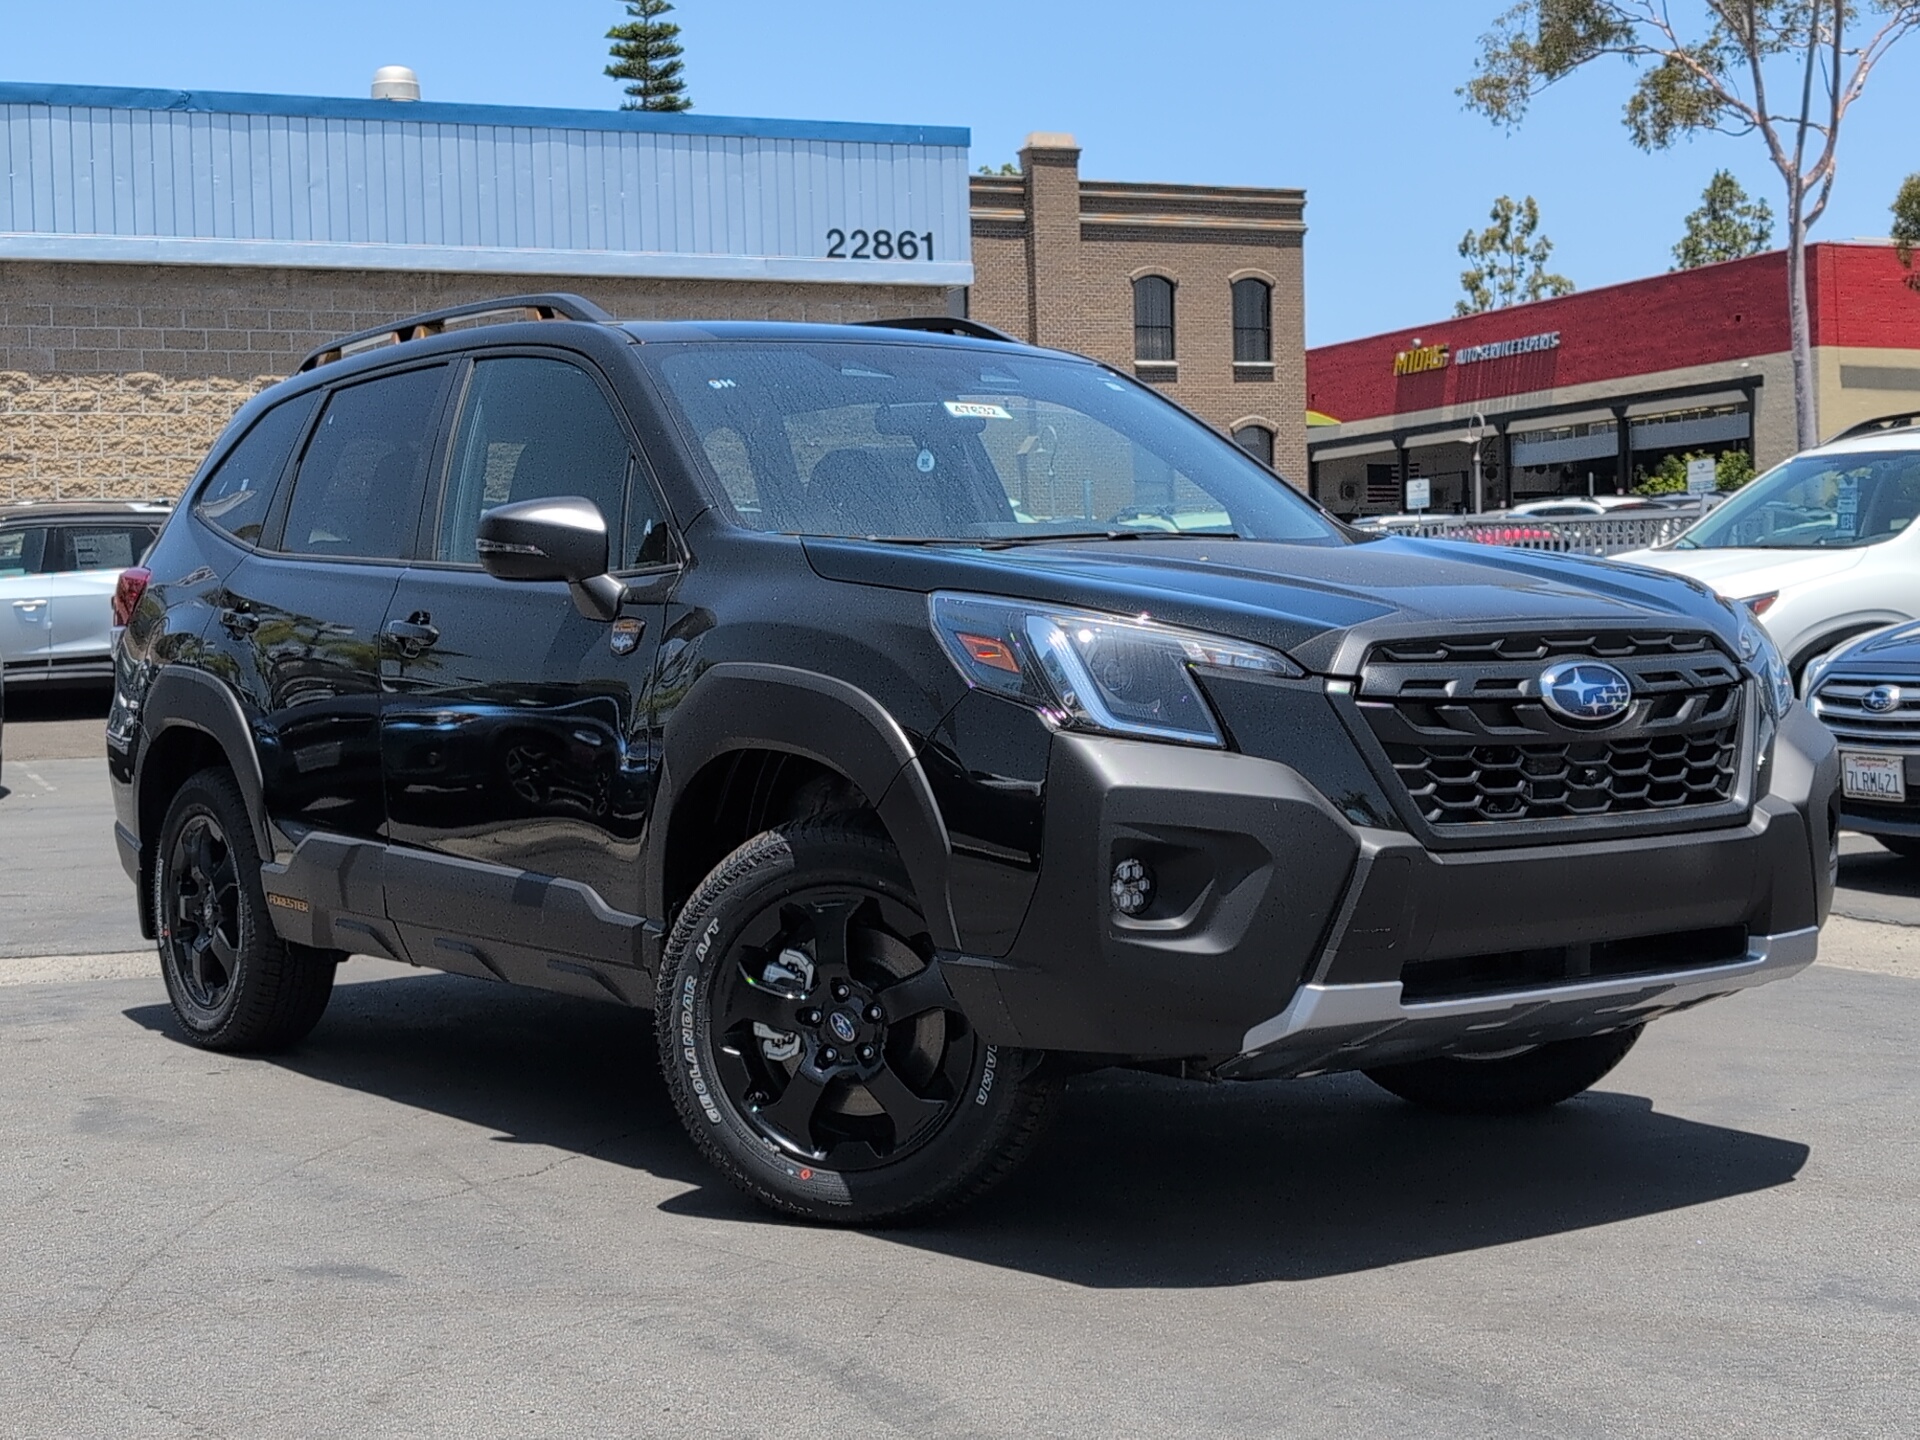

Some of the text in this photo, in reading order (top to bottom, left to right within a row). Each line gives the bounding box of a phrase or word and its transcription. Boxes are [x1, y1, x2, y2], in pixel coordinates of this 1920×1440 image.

[826, 228, 934, 261] 22861
[1847, 770, 1901, 794] 7LRM421
[268, 893, 309, 913] FORESTER
[696, 917, 719, 962] A/T
